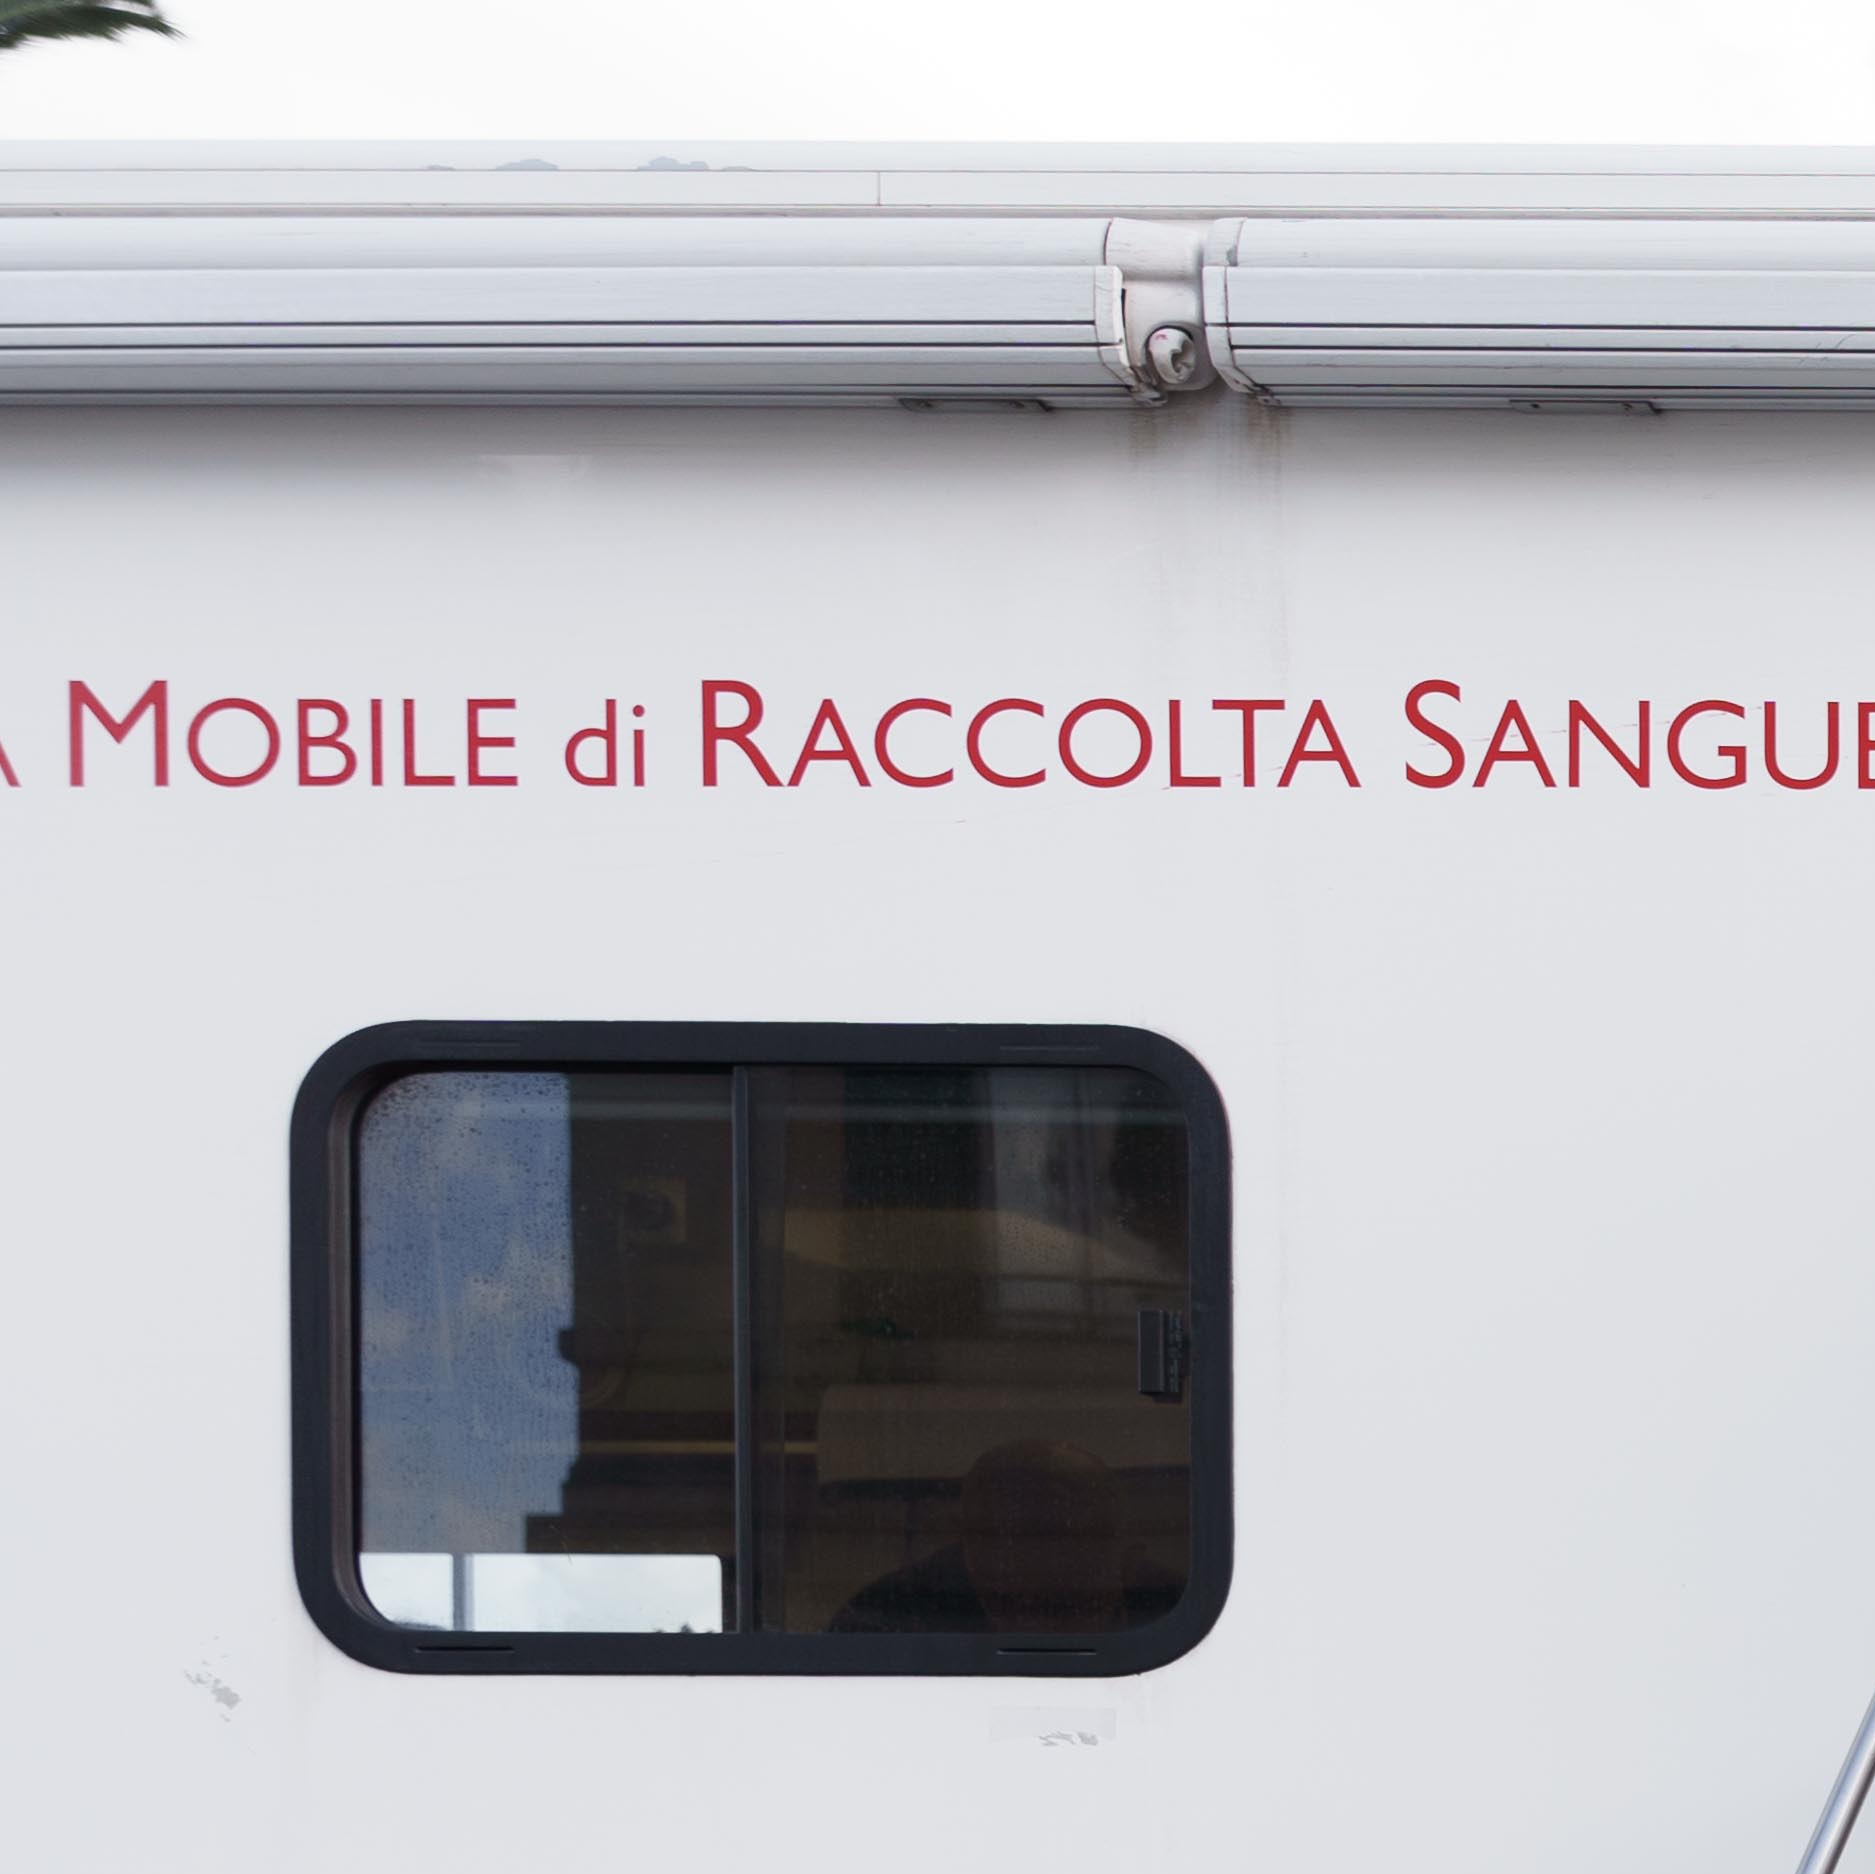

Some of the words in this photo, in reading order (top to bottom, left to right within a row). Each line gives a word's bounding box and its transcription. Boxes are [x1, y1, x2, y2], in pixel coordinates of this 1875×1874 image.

[69, 680, 520, 789] MOBILE
[565, 699, 646, 788] di
[702, 680, 1361, 789] RACCOLTA
